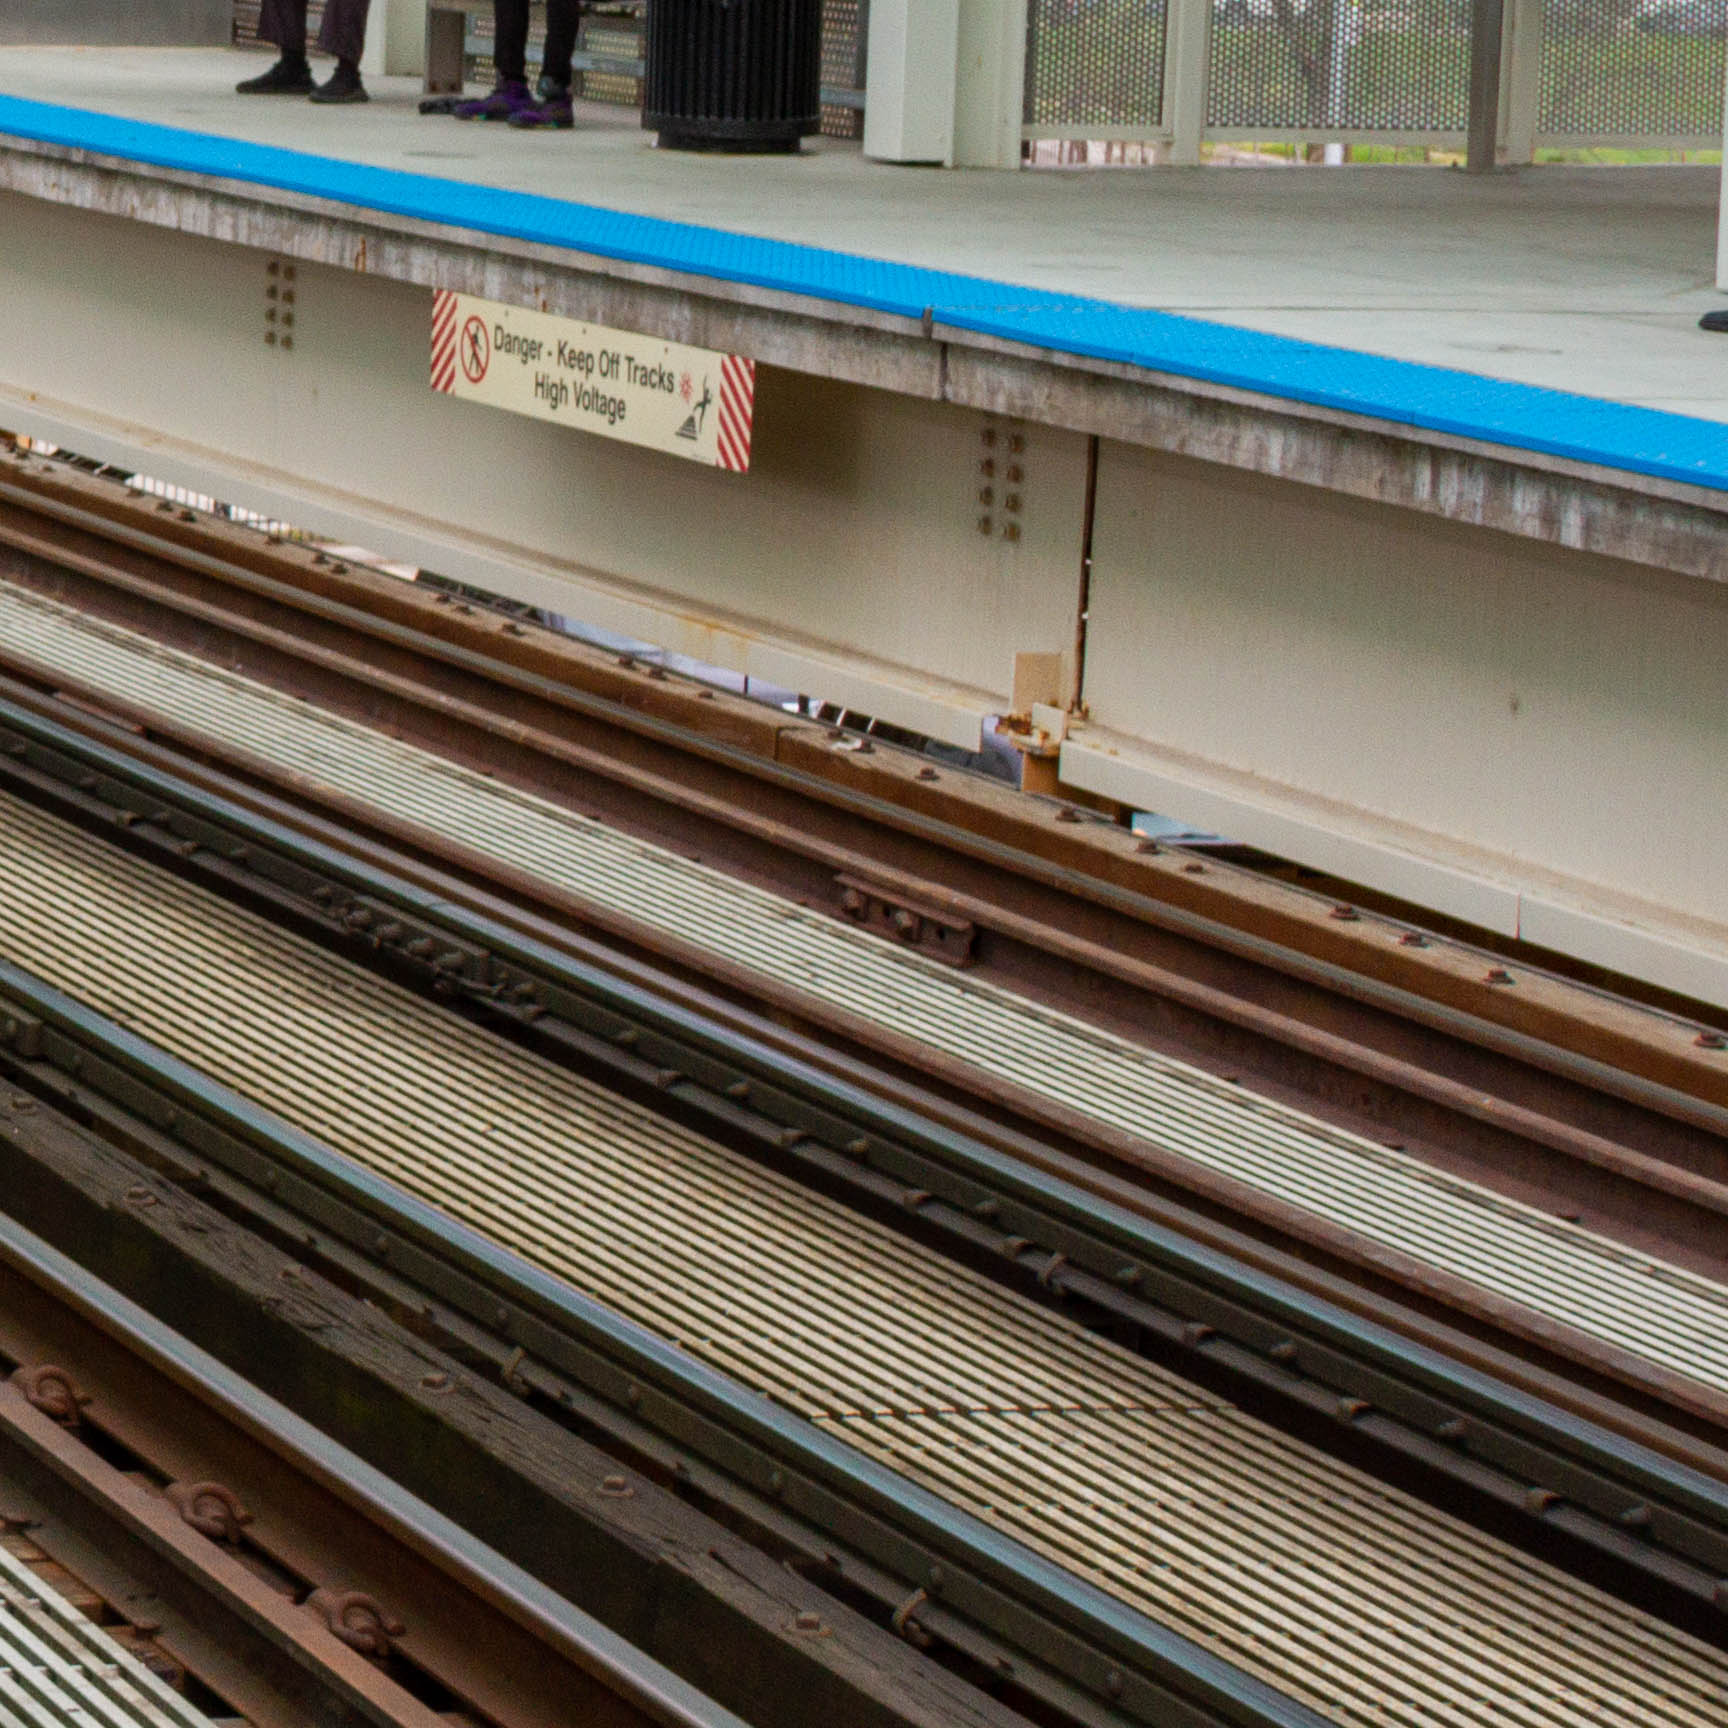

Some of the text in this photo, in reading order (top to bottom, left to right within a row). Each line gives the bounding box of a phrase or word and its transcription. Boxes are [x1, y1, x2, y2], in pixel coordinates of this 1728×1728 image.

[494, 325, 543, 365] Danger
[557, 339, 594, 377] Keep
[599, 349, 620, 379] Off
[625, 355, 675, 394] Tracks
[534, 373, 627, 425] High Voltage
